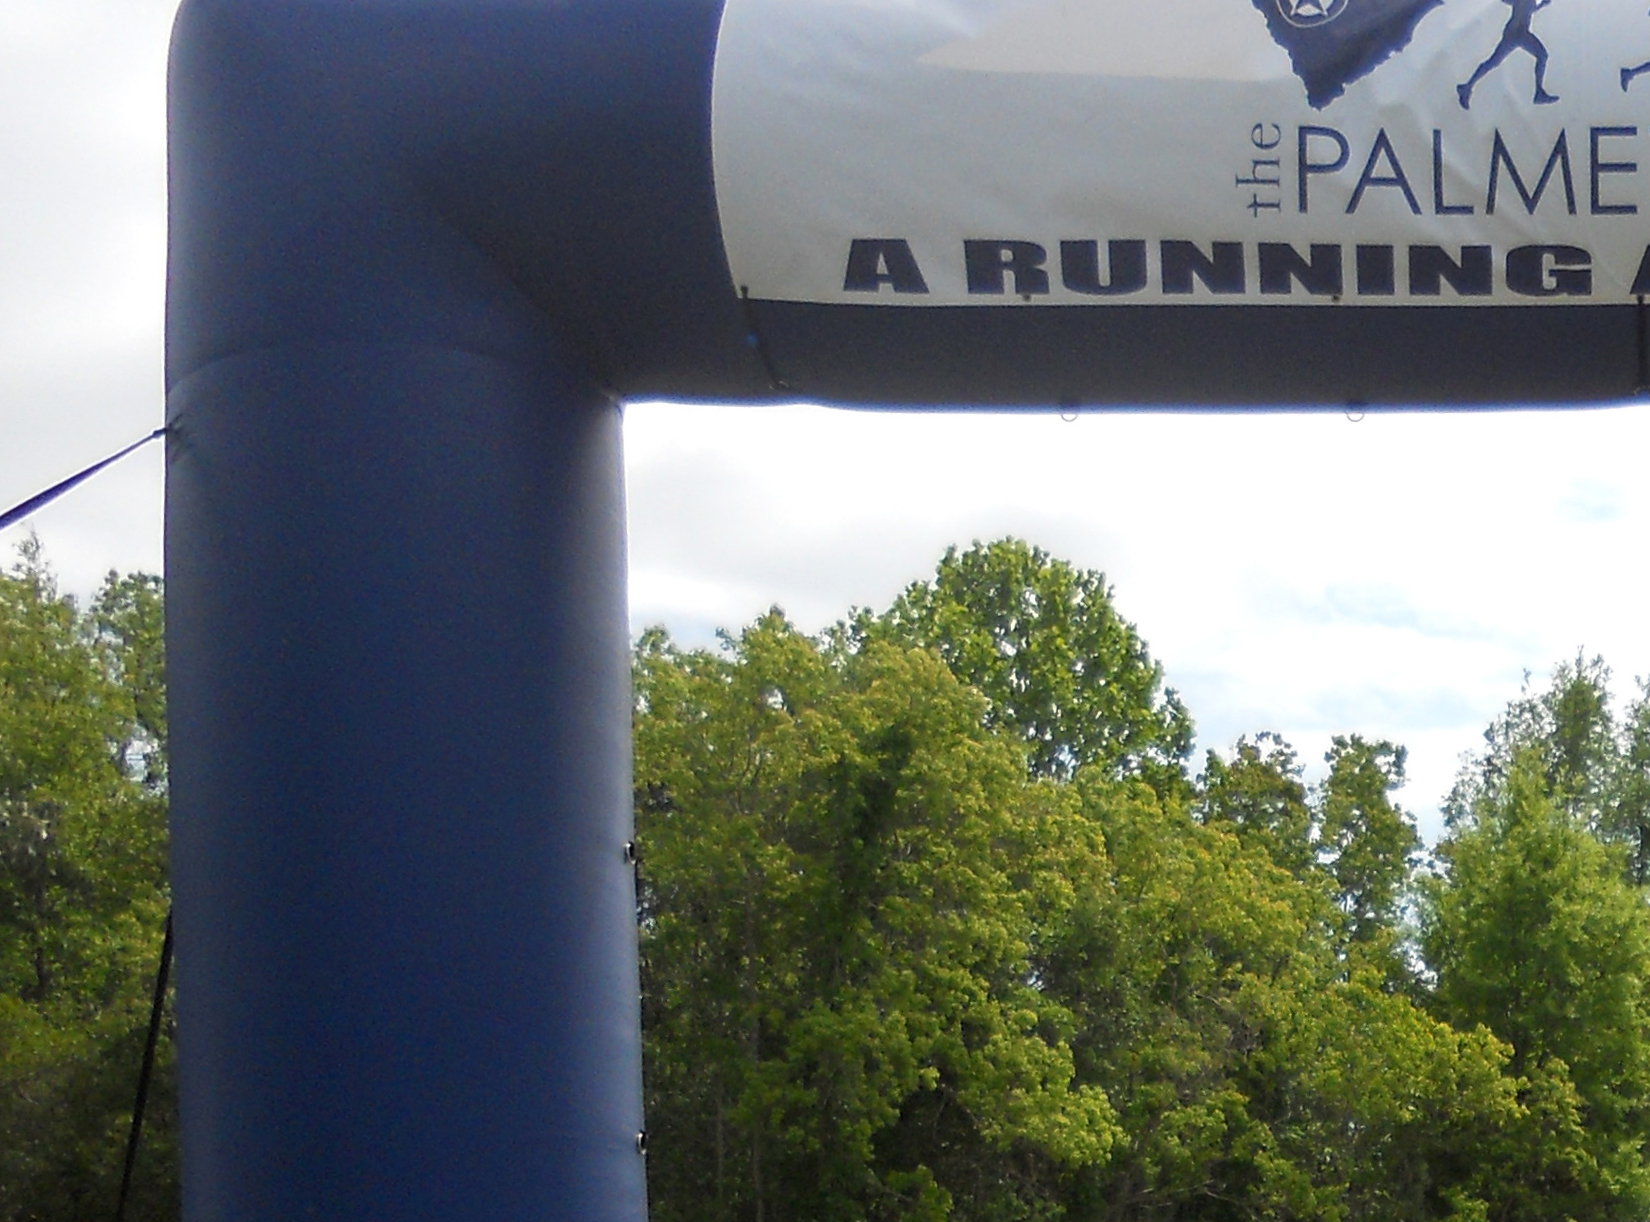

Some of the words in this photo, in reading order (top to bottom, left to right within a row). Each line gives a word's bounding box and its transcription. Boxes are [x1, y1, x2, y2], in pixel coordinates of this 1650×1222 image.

[1235, 121, 1282, 218] the
[843, 238, 929, 296] A
[964, 238, 1594, 298] RUNNING
